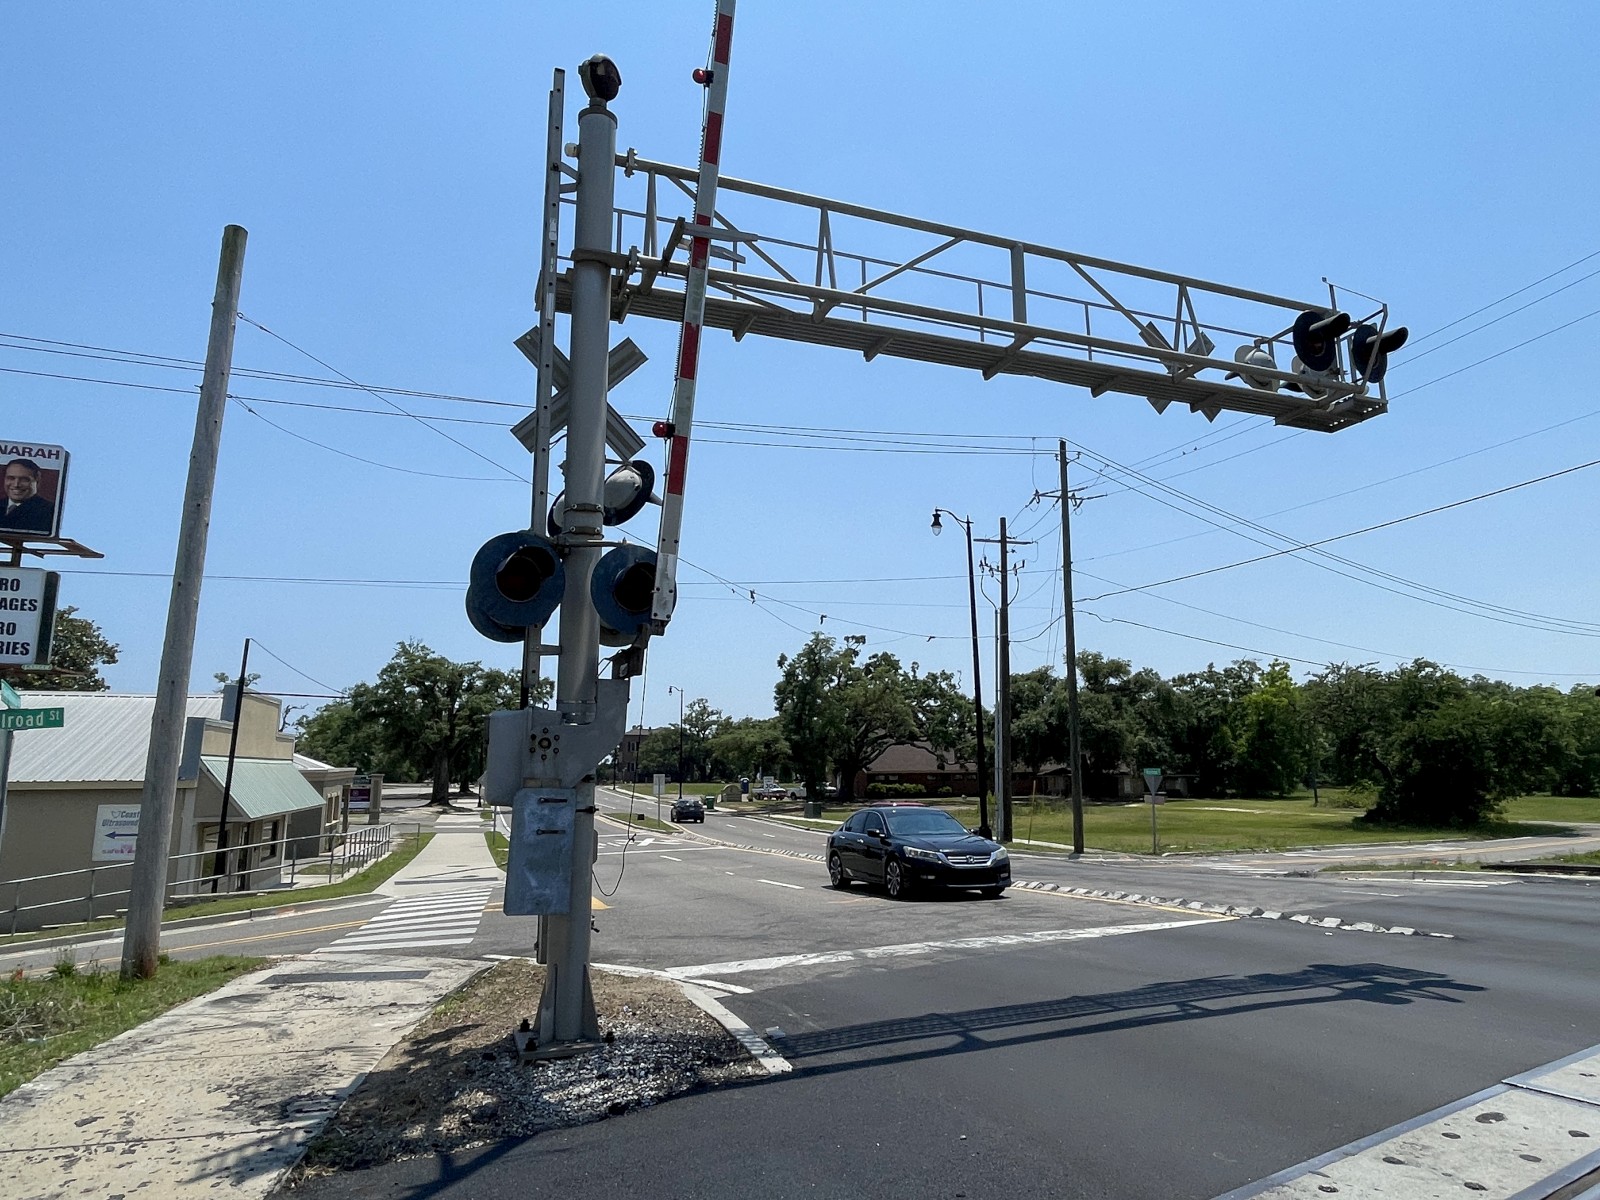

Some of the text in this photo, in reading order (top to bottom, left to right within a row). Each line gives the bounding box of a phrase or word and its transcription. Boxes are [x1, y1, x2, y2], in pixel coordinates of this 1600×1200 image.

[0, 444, 60, 460] NARAH
[0, 577, 21, 592] RO
[0, 597, 38, 612] AGES
[1, 710, 60, 728] lroad St
